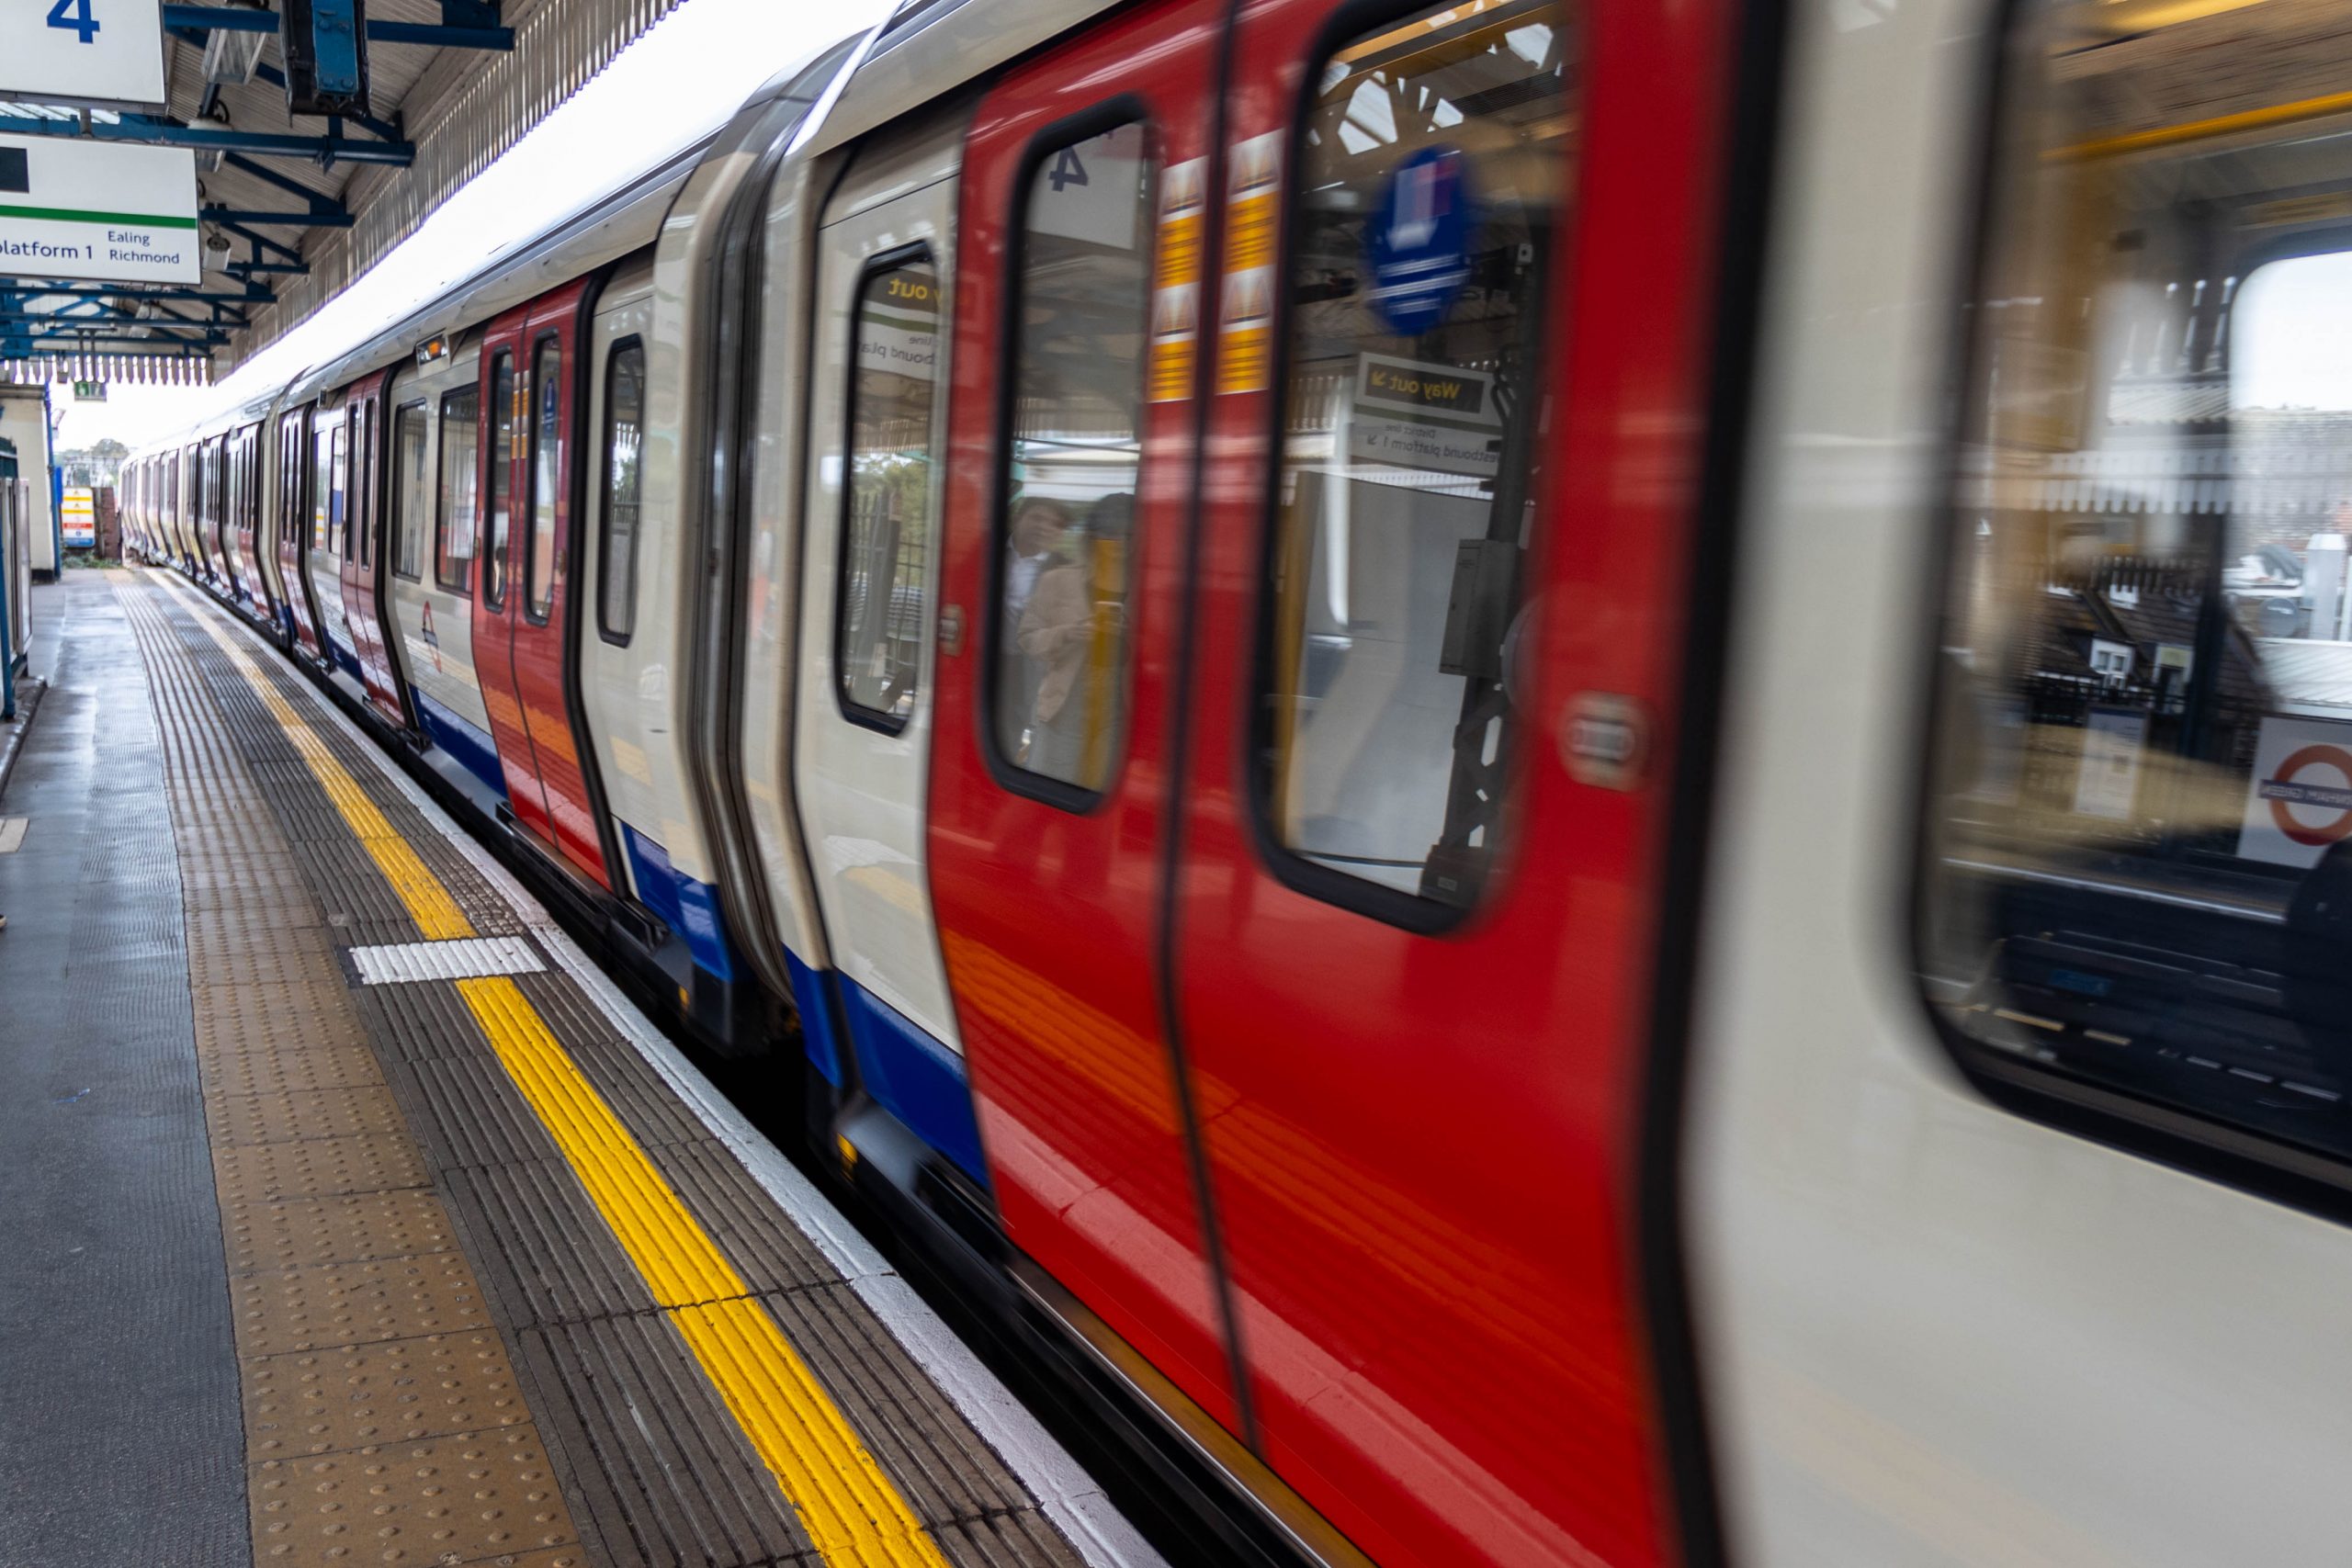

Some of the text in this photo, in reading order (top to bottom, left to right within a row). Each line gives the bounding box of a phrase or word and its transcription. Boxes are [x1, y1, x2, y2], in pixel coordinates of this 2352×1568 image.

[47, 0, 100, 44] 4
[107, 231, 150, 246] Ealing
[85, 245, 93, 259] 1
[109, 249, 180, 264] Richmond
